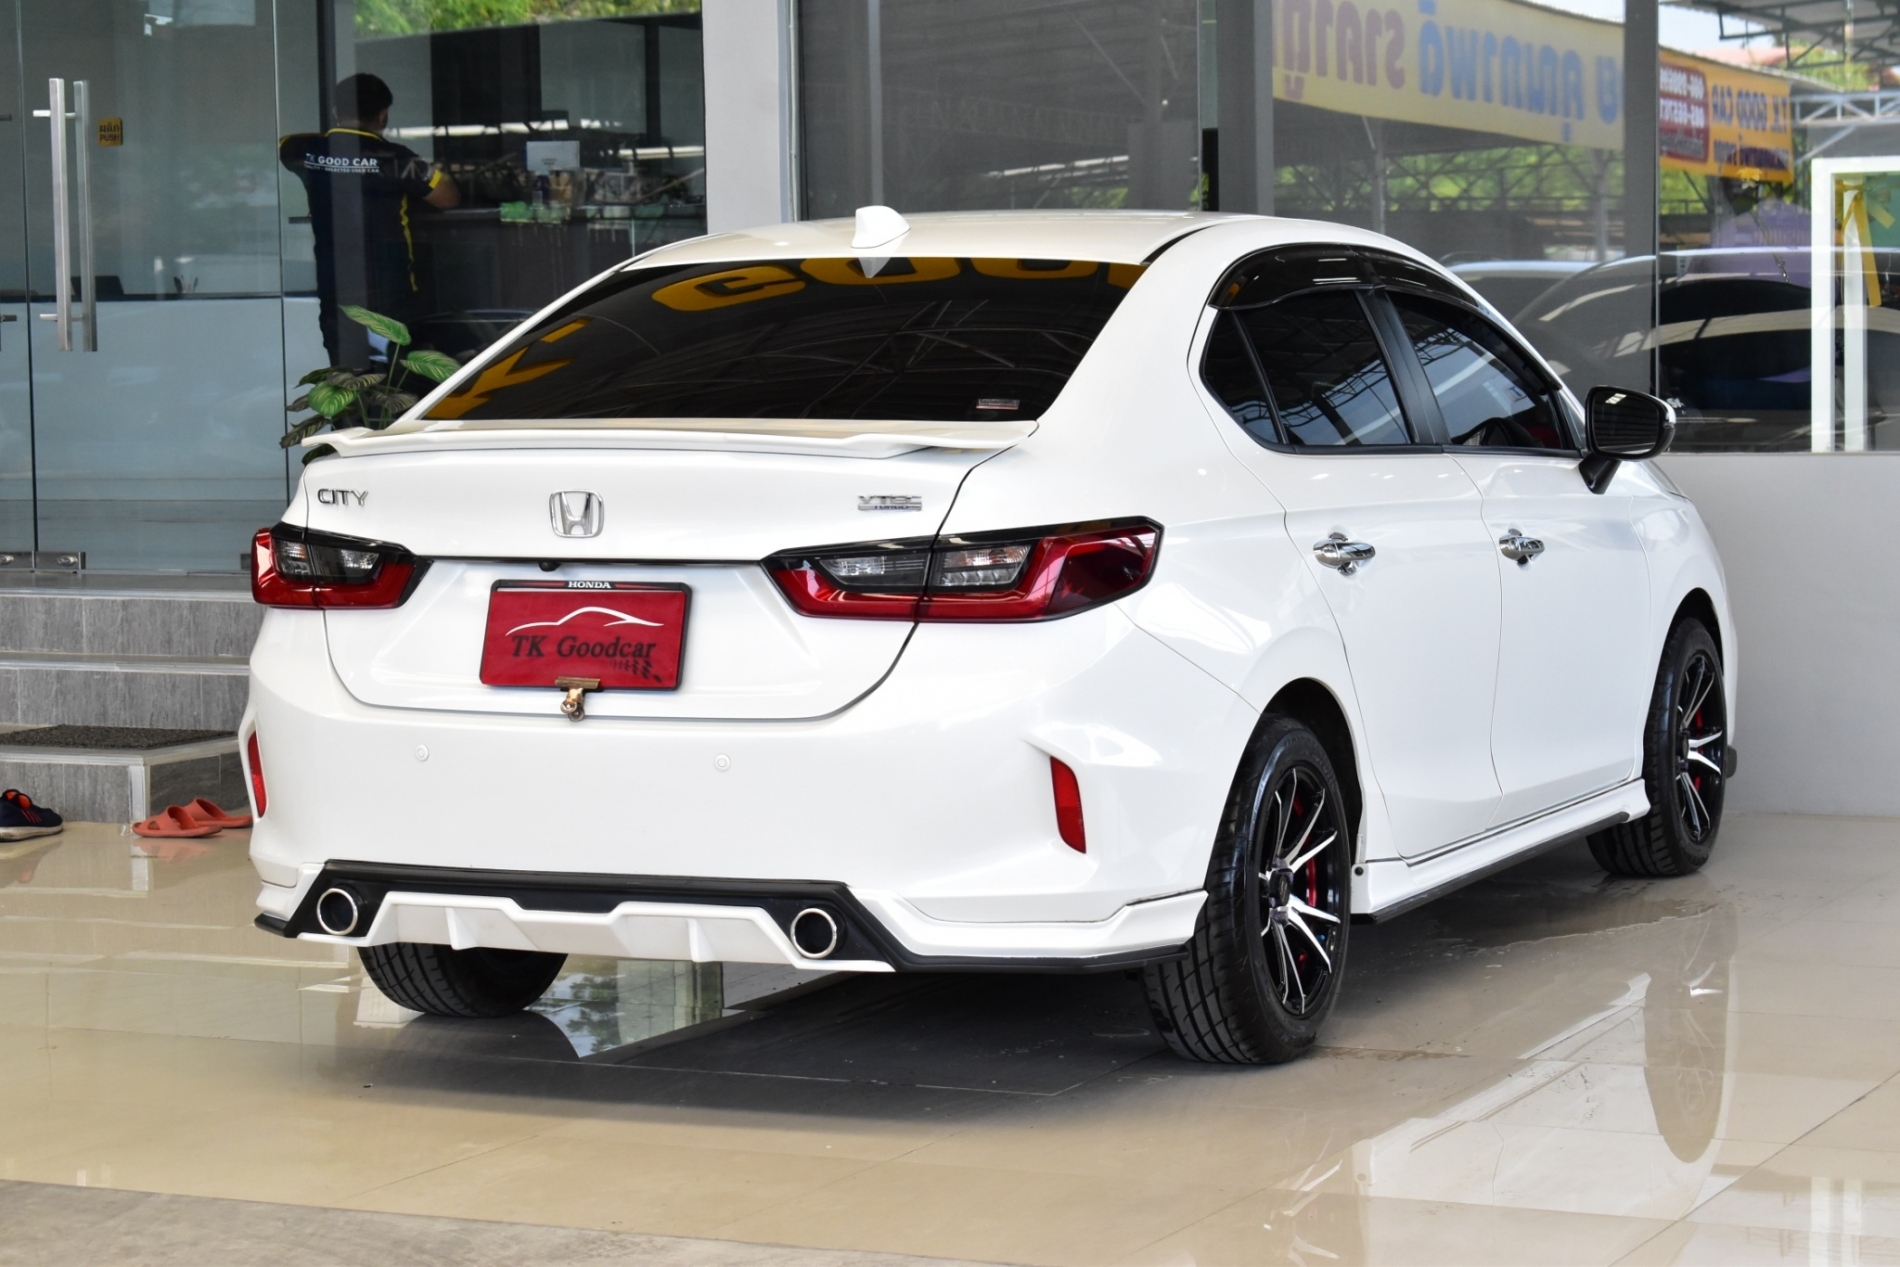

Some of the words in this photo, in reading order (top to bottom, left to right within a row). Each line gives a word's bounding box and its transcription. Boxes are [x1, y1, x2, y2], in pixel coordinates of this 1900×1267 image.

[317, 155, 350, 167] GOOD
[352, 157, 378, 167] CAR
[317, 488, 369, 507] CITY
[567, 580, 612, 589] HONDA
[511, 635, 548, 658] TK
[556, 634, 657, 659] Goodcar
